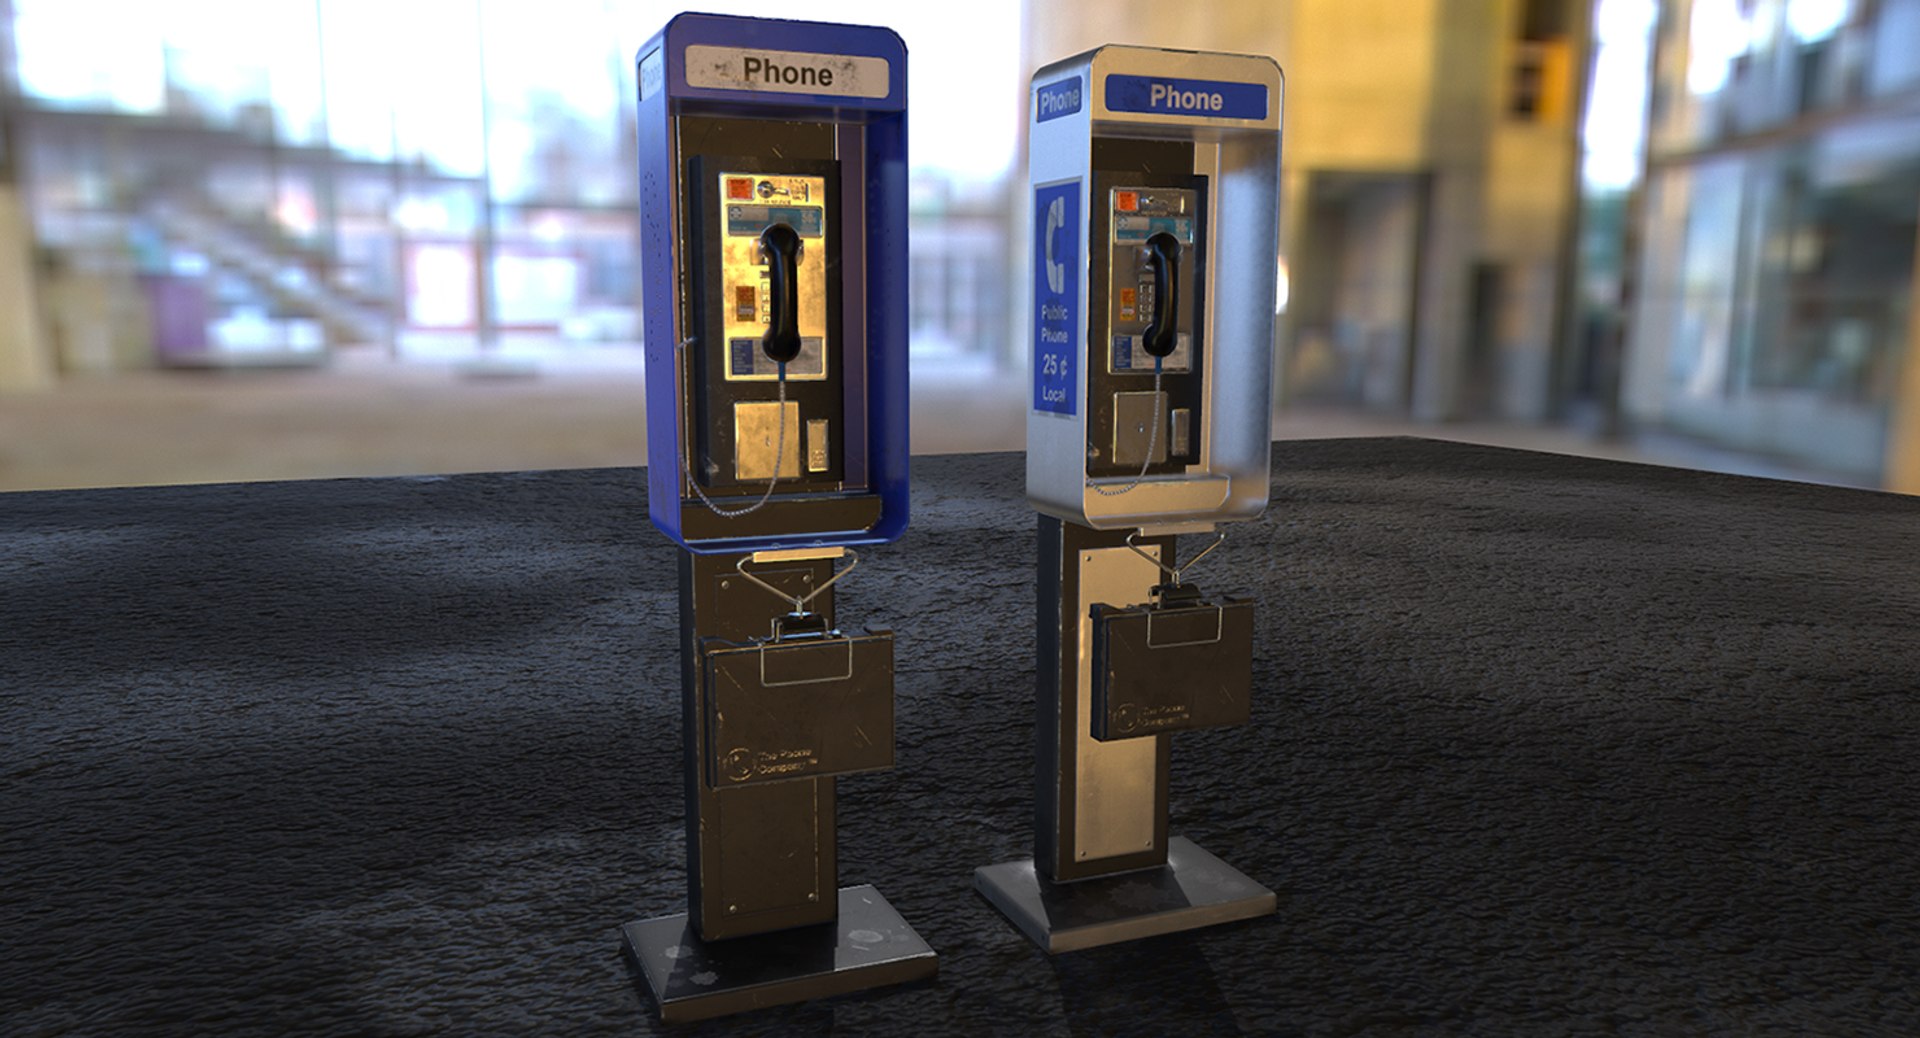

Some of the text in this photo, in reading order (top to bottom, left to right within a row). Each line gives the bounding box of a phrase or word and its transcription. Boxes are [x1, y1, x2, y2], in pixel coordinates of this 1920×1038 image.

[744, 57, 833, 87] Phone
[1041, 88, 1079, 115] Phone
[1150, 84, 1223, 111] Phone
[1041, 304, 1068, 321] Public
[1041, 327, 1068, 343] Phone
[1043, 353, 1057, 375] 25
[1042, 385, 1066, 402] Local
